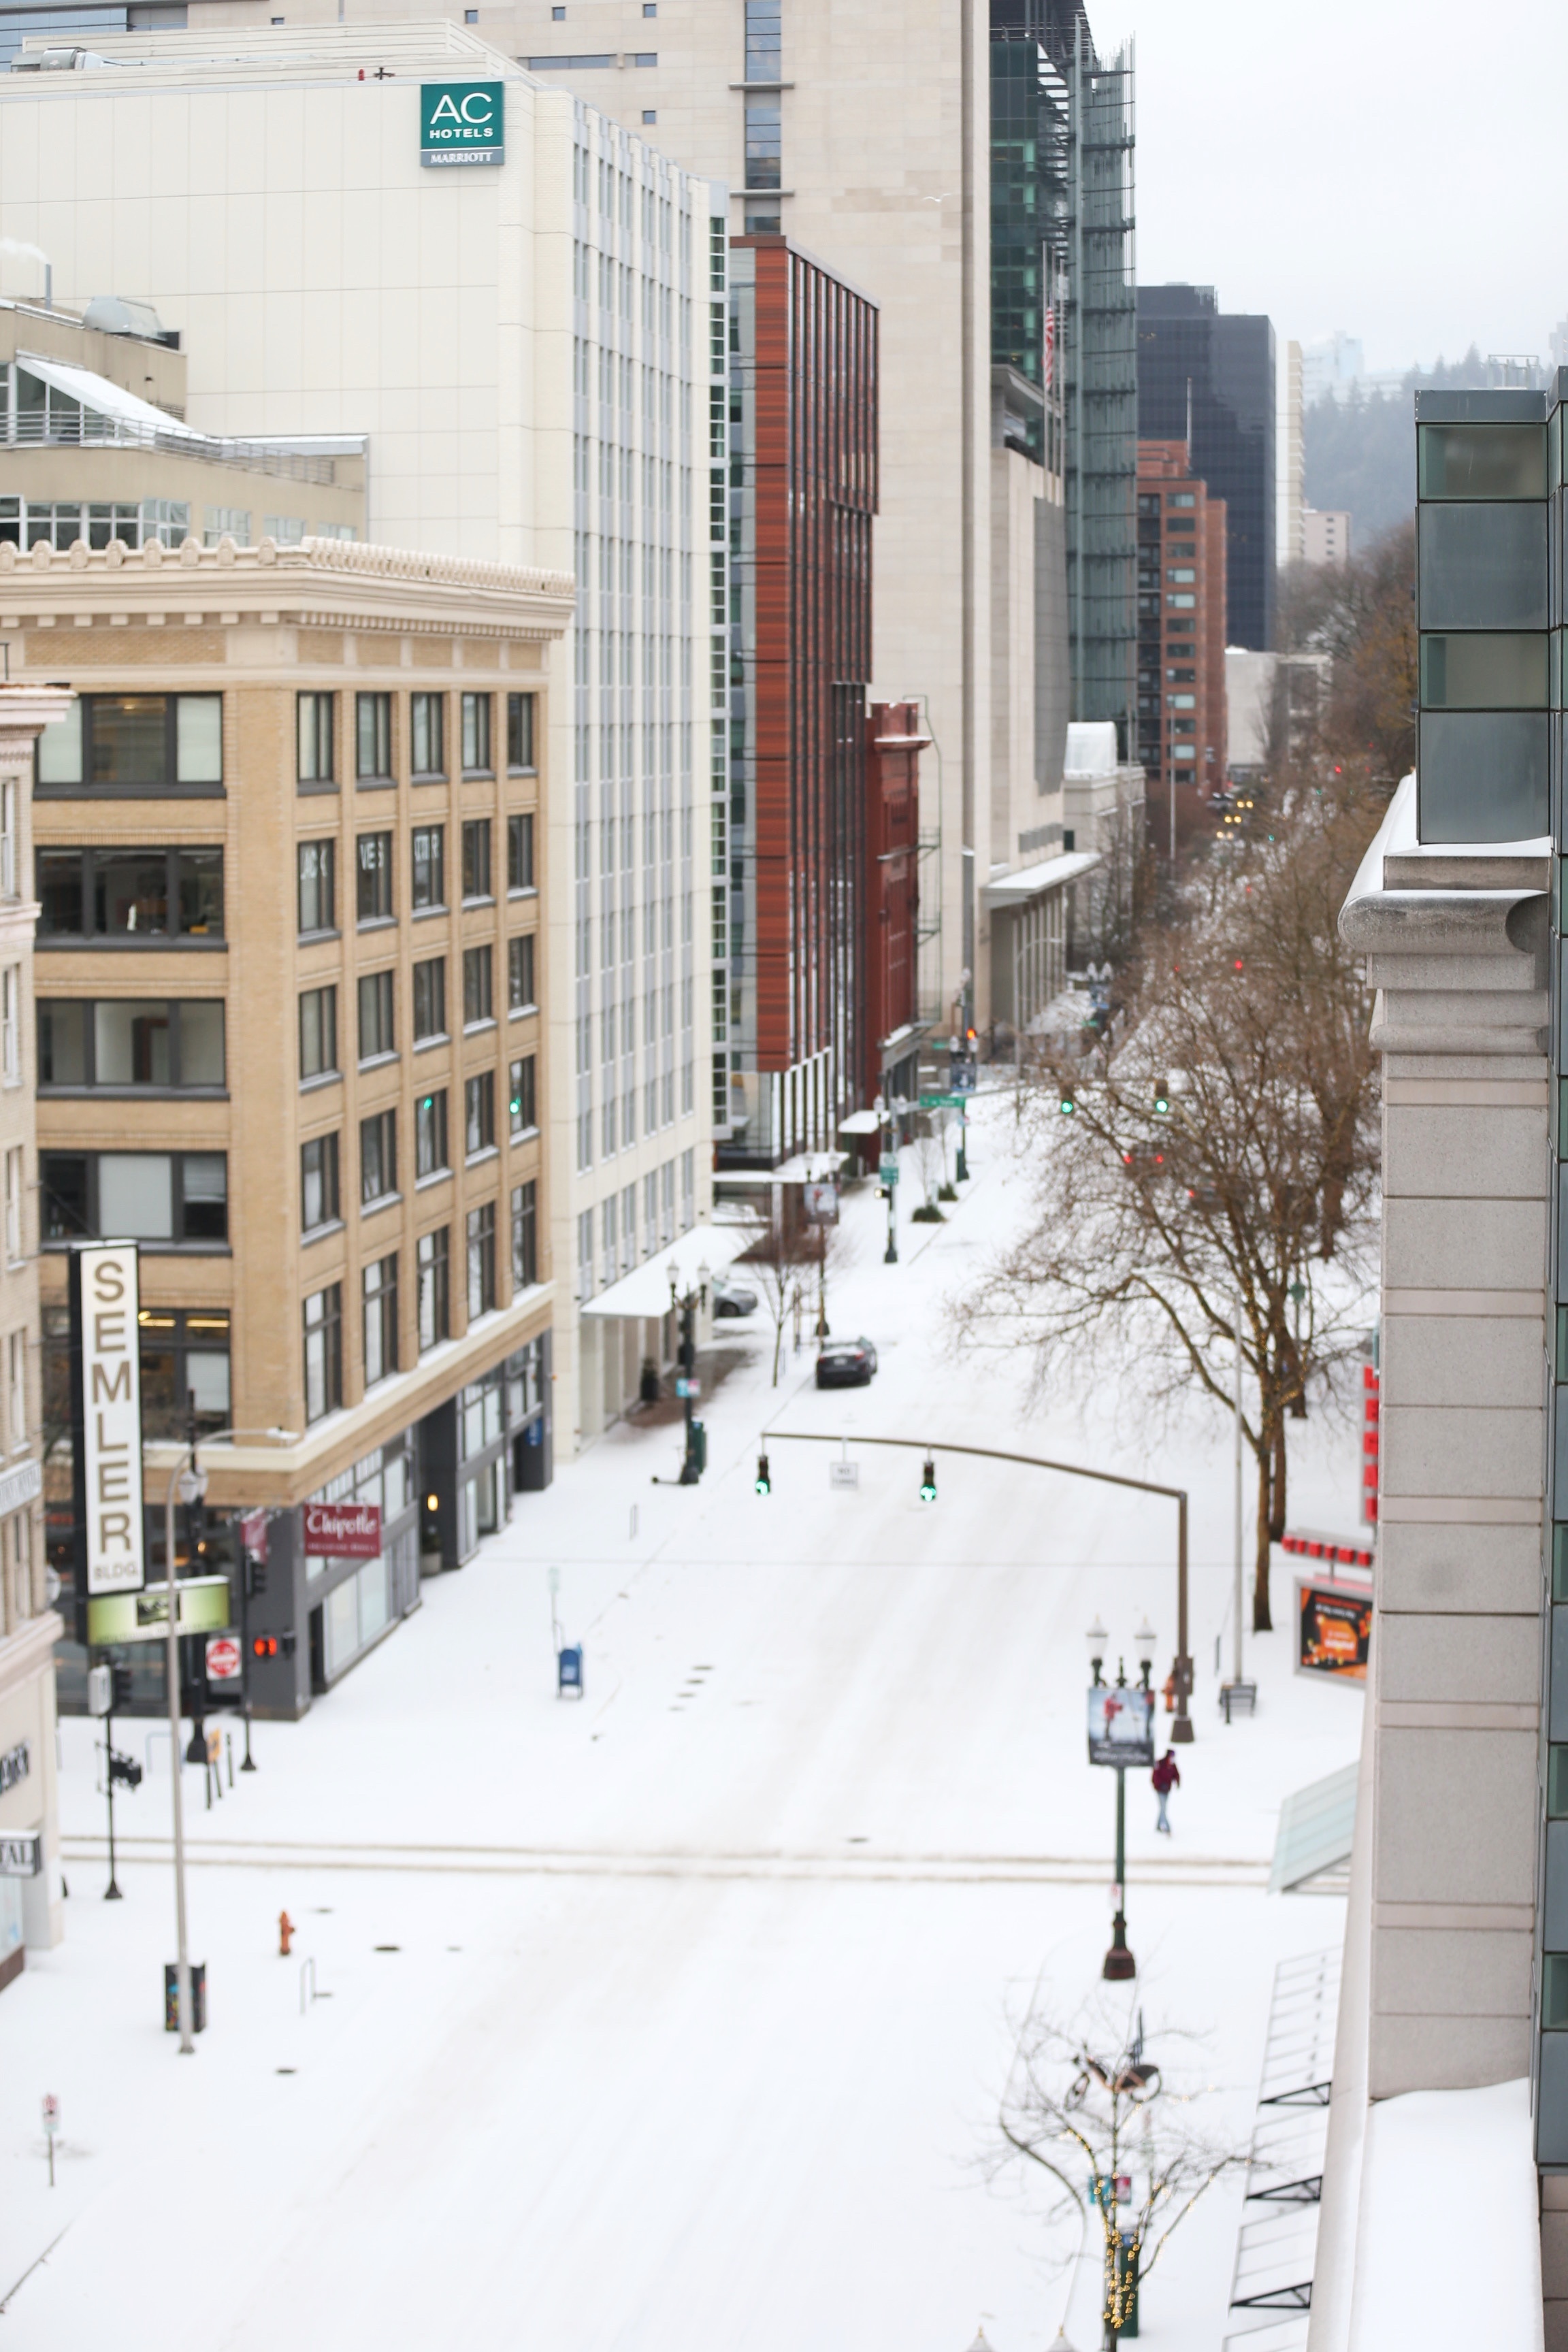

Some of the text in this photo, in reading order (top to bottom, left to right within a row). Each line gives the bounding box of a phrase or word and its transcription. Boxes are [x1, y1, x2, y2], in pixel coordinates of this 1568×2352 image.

[430, 93, 493, 125] AC
[429, 127, 493, 139] HOTELS
[430, 152, 493, 163] MARRIOTT
[91, 1261, 131, 1555] SEMLER
[307, 1510, 376, 1540] Chipotle
